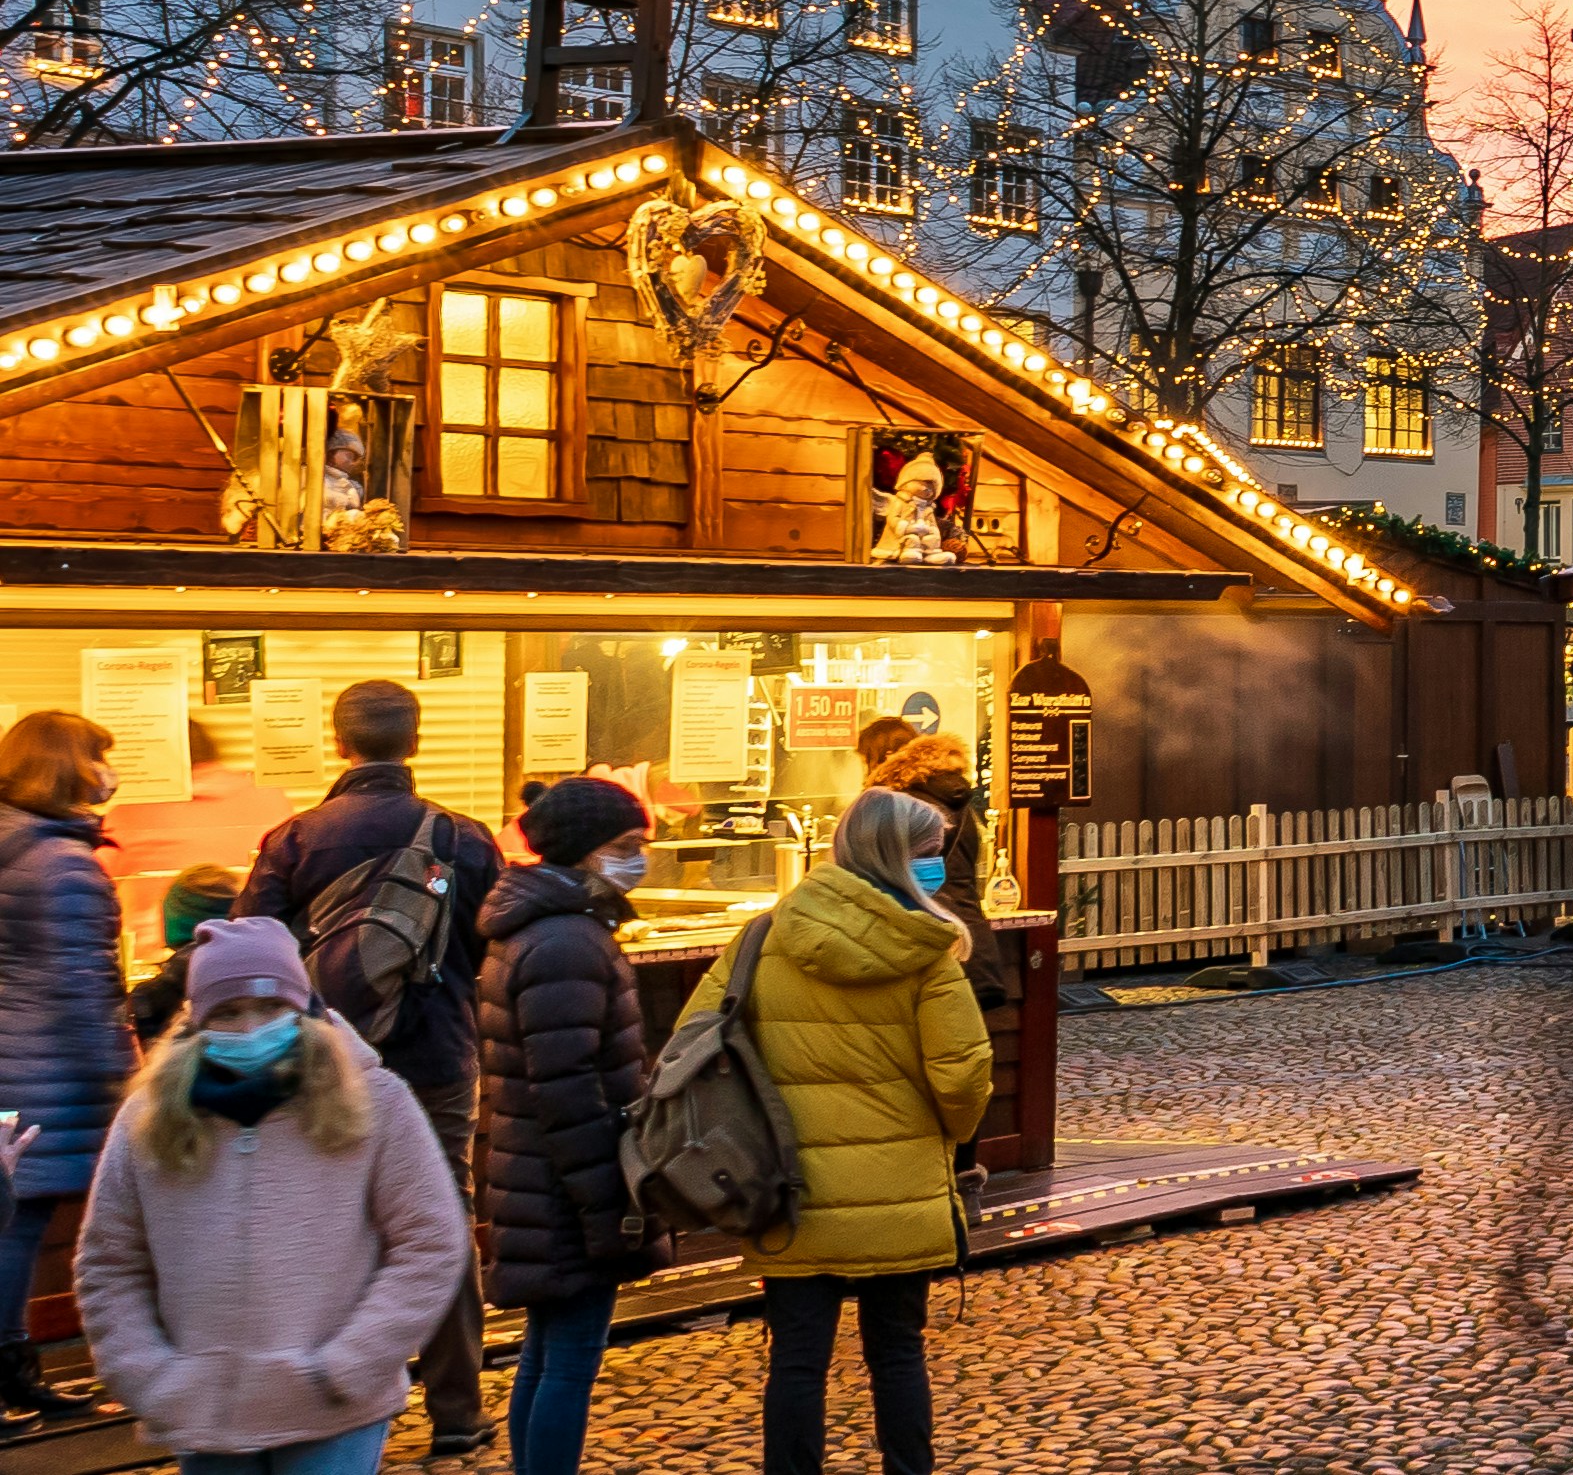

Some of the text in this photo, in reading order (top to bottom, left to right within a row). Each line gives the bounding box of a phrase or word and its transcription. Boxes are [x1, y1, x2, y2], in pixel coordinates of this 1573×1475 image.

[97, 660, 174, 672] Corona-Regeln
[686, 660, 742, 670] Corona-Regeln
[796, 695, 852, 718] 1,50 m
